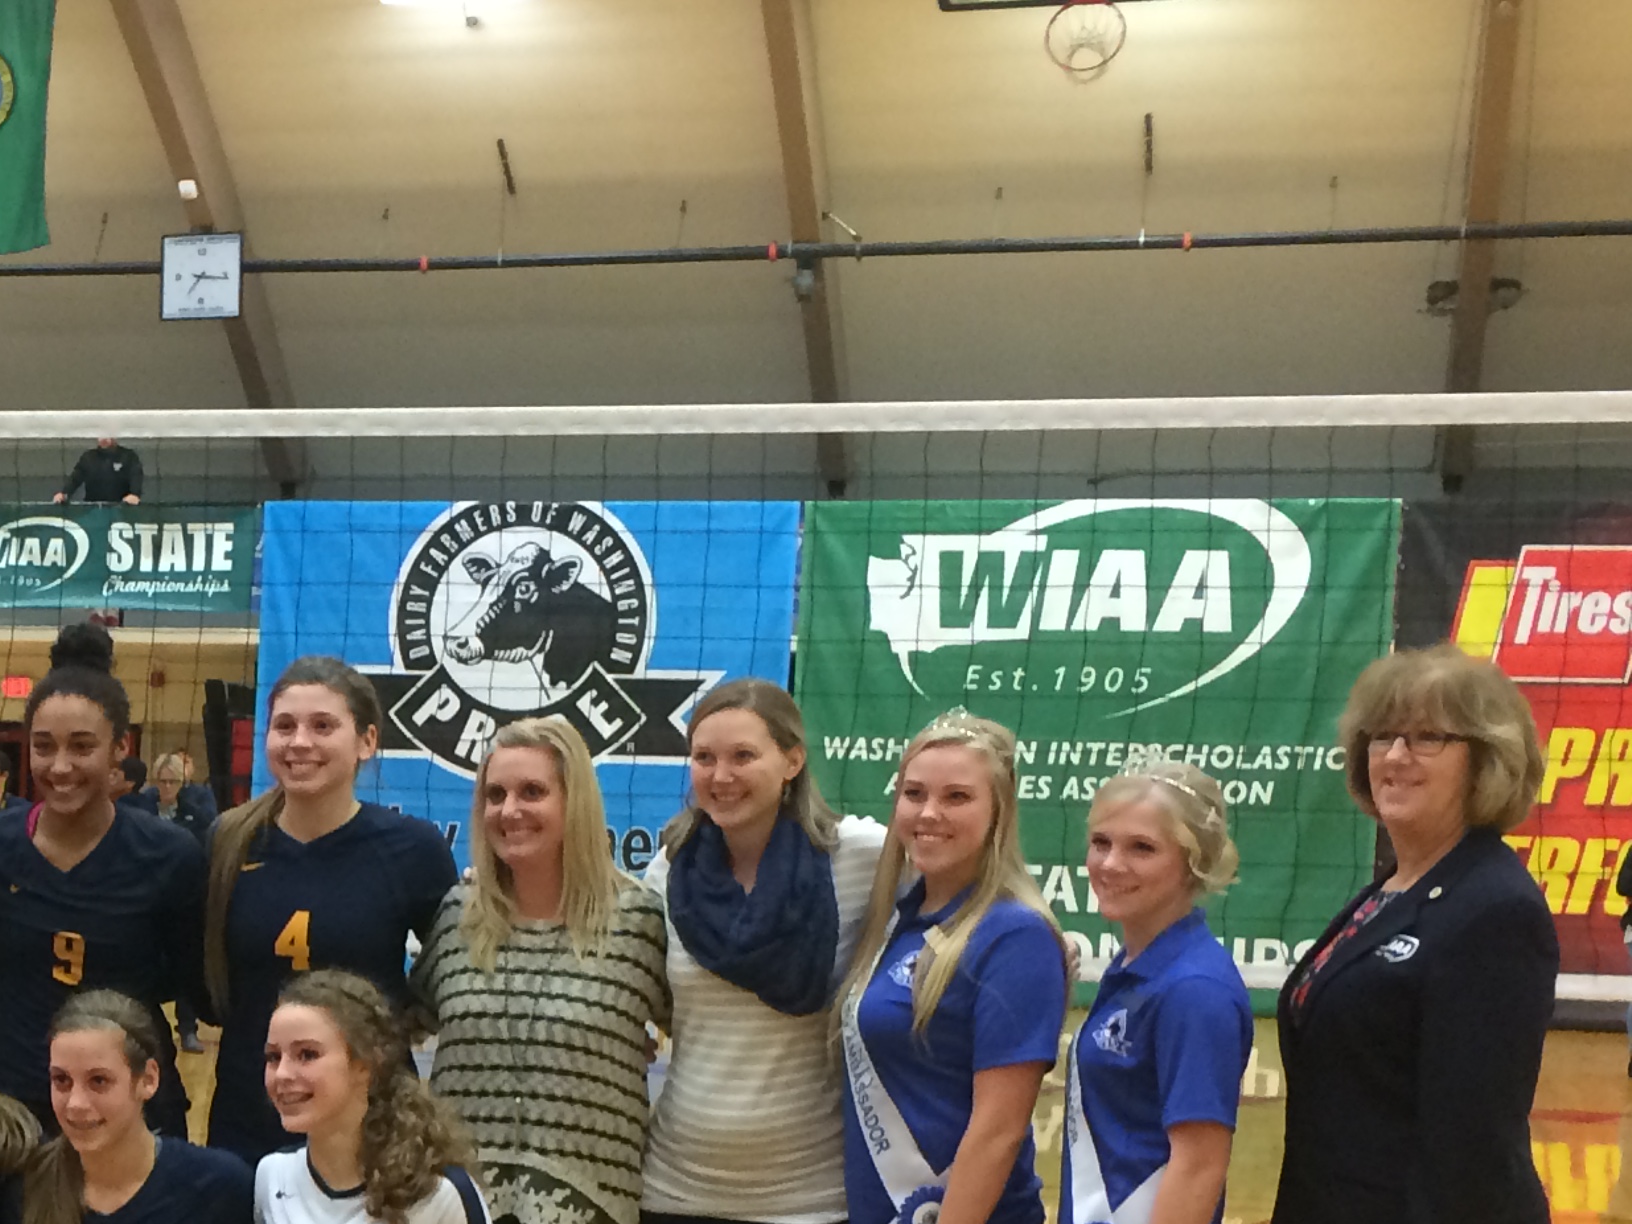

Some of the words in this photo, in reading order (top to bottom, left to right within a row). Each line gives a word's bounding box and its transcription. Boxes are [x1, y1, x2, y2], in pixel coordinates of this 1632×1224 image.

[106, 522, 235, 573] STATE
[102, 574, 232, 598] Championships
[405, 583, 431, 661] DAIRY
[419, 501, 517, 578] FARMERS
[530, 501, 560, 525] OF
[567, 510, 641, 665] WASHINGTON
[937, 548, 1233, 634] WIAA
[1514, 566, 1632, 645] Tires
[411, 682, 624, 764] PRE
[51, 931, 85, 986] 9
[274, 910, 311, 970] 4
